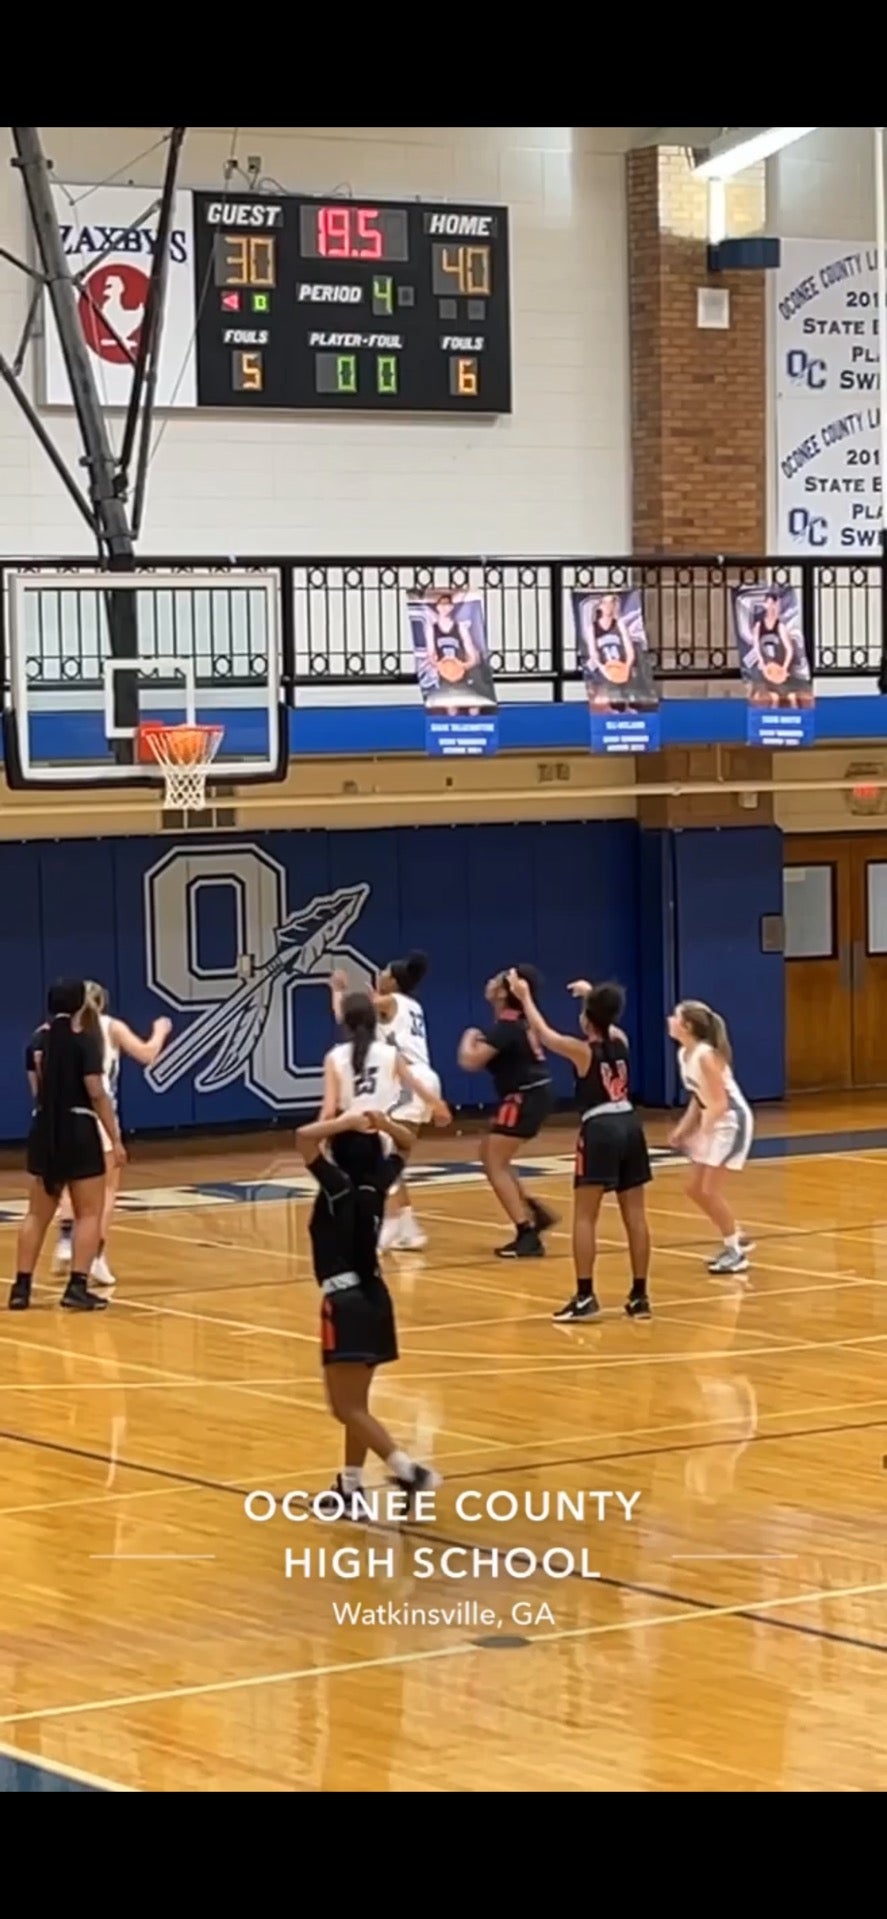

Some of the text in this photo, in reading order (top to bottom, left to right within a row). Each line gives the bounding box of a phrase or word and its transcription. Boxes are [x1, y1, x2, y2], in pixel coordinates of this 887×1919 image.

[207, 203, 281, 227] GUEST
[317, 207, 383, 259] 19.5
[430, 213, 492, 236] HOME
[224, 235, 275, 288] 30
[441, 245, 491, 295] 40
[299, 284, 362, 304] PERIOD
[373, 276, 393, 316] 4
[778, 275, 820, 321] OCONEE
[819, 252, 863, 289] COUNTY
[223, 329, 269, 344] FOULS
[441, 336, 485, 351] FOULS
[802, 317, 865, 335] STATE
[241, 352, 263, 390] 5
[337, 355, 398, 394] 0 0
[457, 358, 478, 396] 6
[780, 433, 821, 480] OCONEE
[820, 411, 865, 447] COUNTY
[804, 476, 865, 493] STATE
